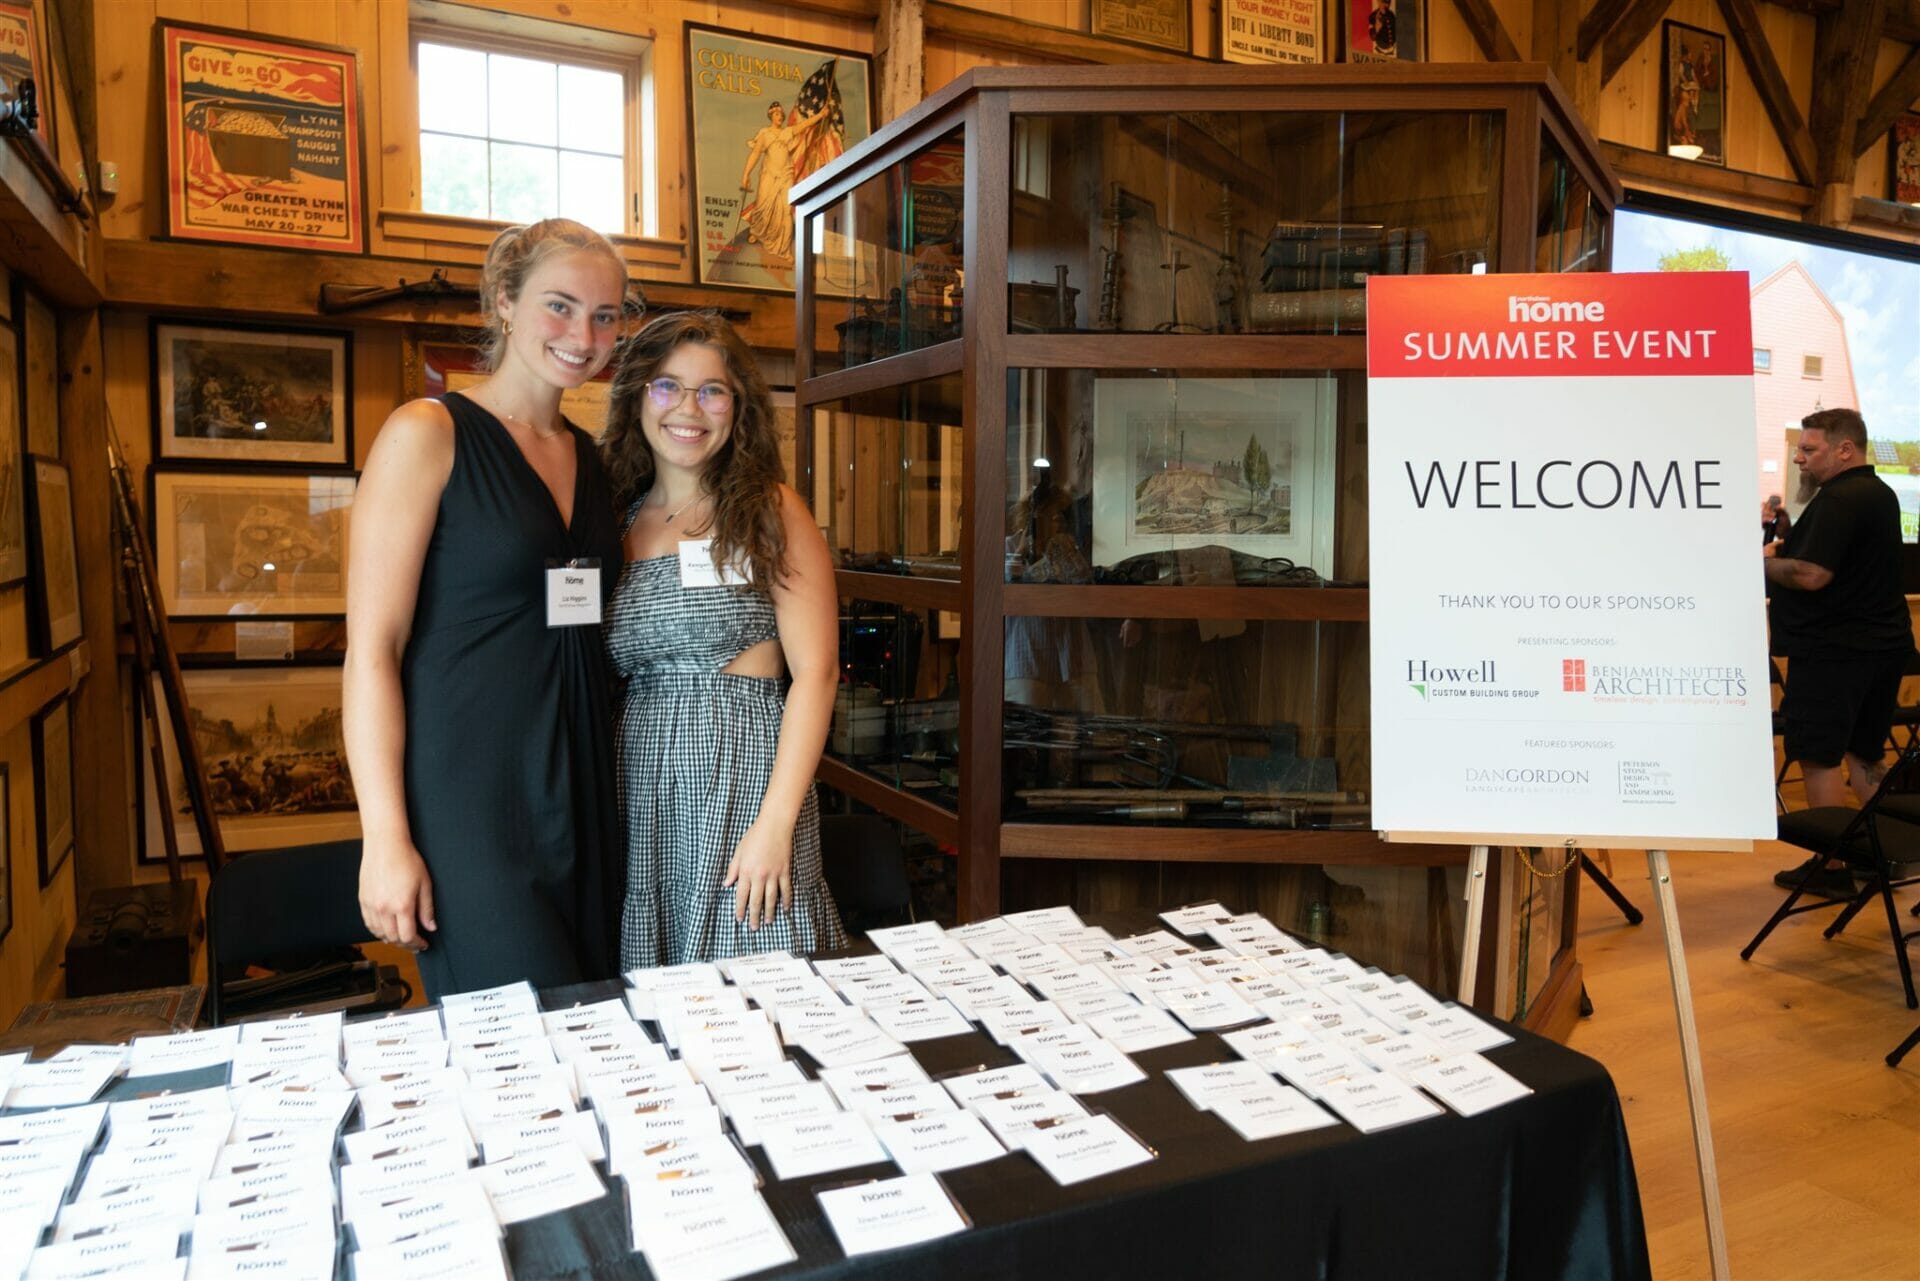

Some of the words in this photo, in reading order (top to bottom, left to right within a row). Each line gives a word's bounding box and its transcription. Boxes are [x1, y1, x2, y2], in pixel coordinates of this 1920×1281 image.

[1237, 1, 1258, 13] YOUR
[1262, 5, 1290, 20] MONEY
[1293, 13, 1310, 26] CAN
[1126, 13, 1174, 37] INVEST
[1231, 16, 1246, 33] BUY
[1250, 20, 1256, 35] A
[1259, 23, 1292, 43] LIBERTY
[1295, 31, 1314, 48] BOND
[1232, 40, 1249, 51] UNCLE
[1250, 44, 1263, 54] SAM
[1264, 48, 1277, 58] WILL
[1279, 50, 1287, 60] DO
[1288, 53, 1299, 63] THE
[188, 55, 233, 77] GIVE
[237, 65, 253, 76] OR
[256, 66, 282, 83] GO
[697, 47, 804, 82] COLUMBIA
[698, 71, 762, 97] CALLS
[301, 115, 338, 126] LYNN
[282, 124, 342, 140] SWAMPSCOTT
[297, 139, 337, 152] SAUGUS
[298, 153, 341, 165] NAHANT
[244, 192, 308, 207] GREATER
[312, 198, 345, 210] LYNN
[705, 196, 739, 208] ENLIST
[221, 202, 250, 214] WAR
[252, 206, 300, 219] CHEST
[304, 211, 344, 223] DRIVE
[705, 209, 730, 218] NOW
[245, 218, 274, 229] MAY
[279, 220, 295, 231] 20
[306, 222, 323, 233] 27
[706, 220, 725, 228] FOR
[1509, 296, 1605, 323] home
[1404, 330, 1578, 361] SUMMER
[1594, 329, 1717, 359] EVENT
[1404, 459, 1723, 510] WELCOME
[1438, 594, 1496, 609] THANK
[1500, 594, 1535, 609] YOU
[1539, 594, 1561, 609] TO
[1565, 595, 1602, 610] OUR
[1607, 595, 1697, 610] SPONSORS
[1518, 636, 1569, 647] PRESENTING
[1405, 659, 1498, 683] Howell
[1592, 665, 1674, 679] BENJAMIN
[1680, 667, 1745, 679] NUTTER
[1432, 689, 1467, 697] CUSTOM
[1470, 689, 1509, 698] BUILDING
[1512, 690, 1540, 698] GROUP
[1593, 677, 1748, 697] ARCHITECTS
[1524, 739, 1567, 749] FEATURED
